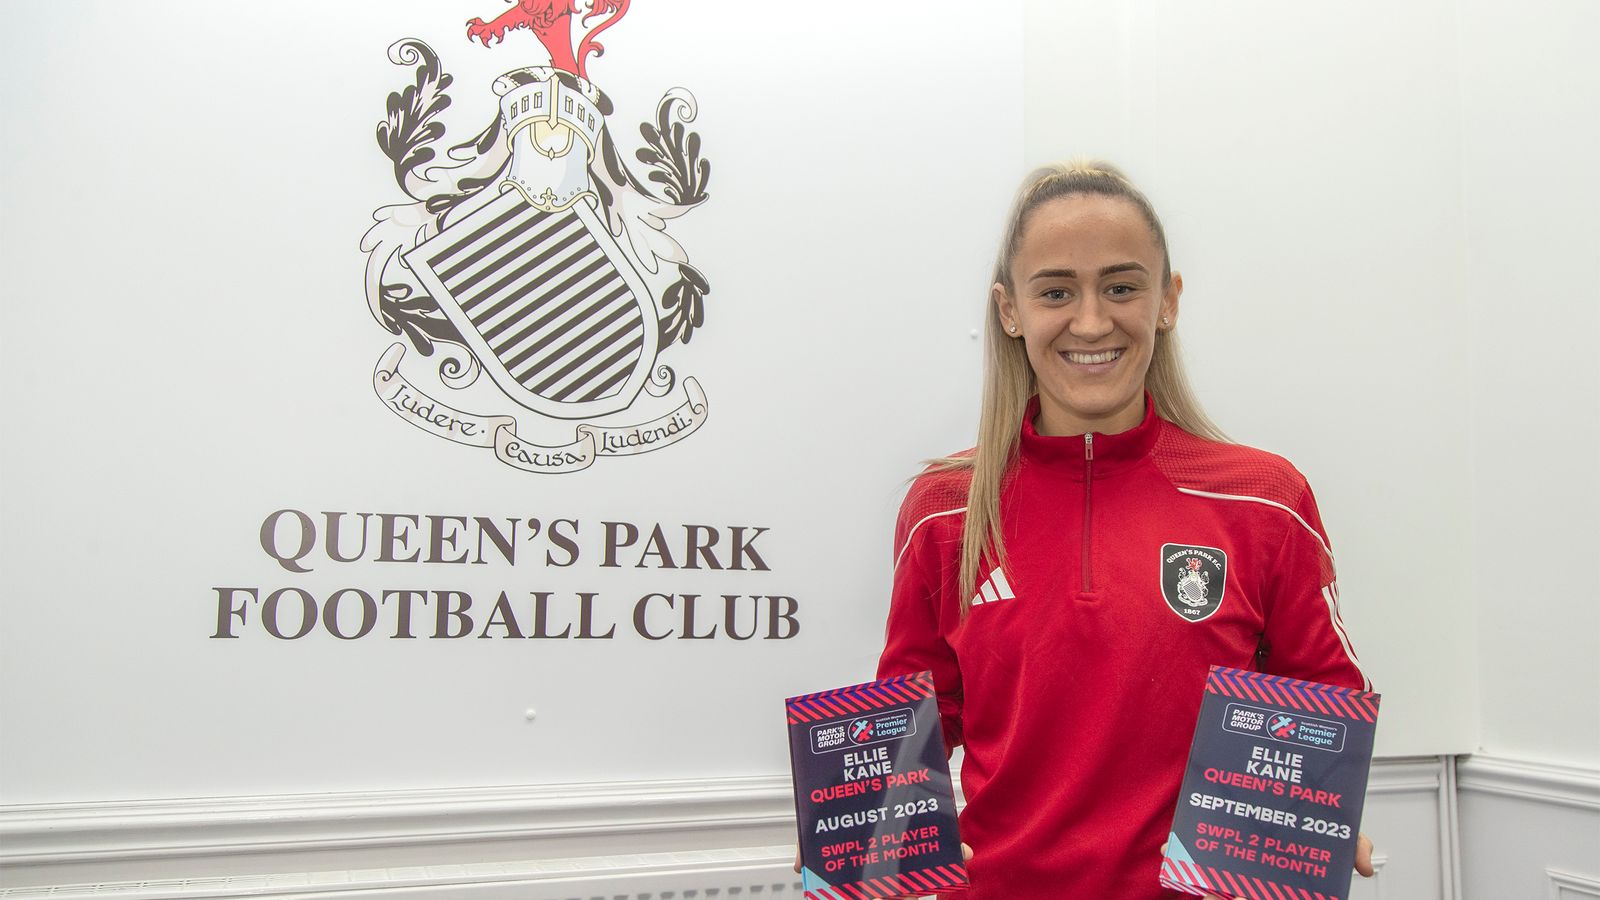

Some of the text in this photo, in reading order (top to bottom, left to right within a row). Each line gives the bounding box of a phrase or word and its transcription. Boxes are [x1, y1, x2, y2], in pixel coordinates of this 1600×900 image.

[505, 442, 586, 467] Causa
[259, 508, 772, 574] QUEEN'S PARK
[1166, 549, 1193, 563] QUEEN'S
[1194, 550, 1213, 561] PARK
[209, 587, 801, 641] FOOTBALL CLUB
[1183, 608, 1201, 616] 1867
[876, 718, 907, 729] Premier
[1231, 715, 1264, 726] MOTOR
[1233, 709, 1265, 720] PARK'S
[817, 726, 844, 737] PARK'S
[817, 732, 845, 742] MOTOR
[877, 725, 907, 737] League
[1230, 721, 1261, 731] GROUP
[1299, 725, 1337, 738] Premier
[818, 738, 845, 748] GROUP
[1298, 732, 1333, 745] League
[843, 747, 889, 767] ELLIE
[1251, 746, 1304, 768] ELLIE
[844, 760, 893, 782] KANE
[1246, 760, 1303, 784] KANE
[810, 768, 930, 803] QUEEN'S PARK
[1204, 767, 1342, 808] QUEEN'S PARK
[815, 798, 939, 833] AUGUST 2023
[1189, 792, 1351, 840] SEPTEMBER 2023
[821, 826, 940, 858] SWPL 2 PLAYER
[1196, 822, 1331, 863] SWPL 2 PLAYER
[825, 840, 940, 872] OF THE MONTH
[1195, 839, 1327, 878] OF THE MONTH
